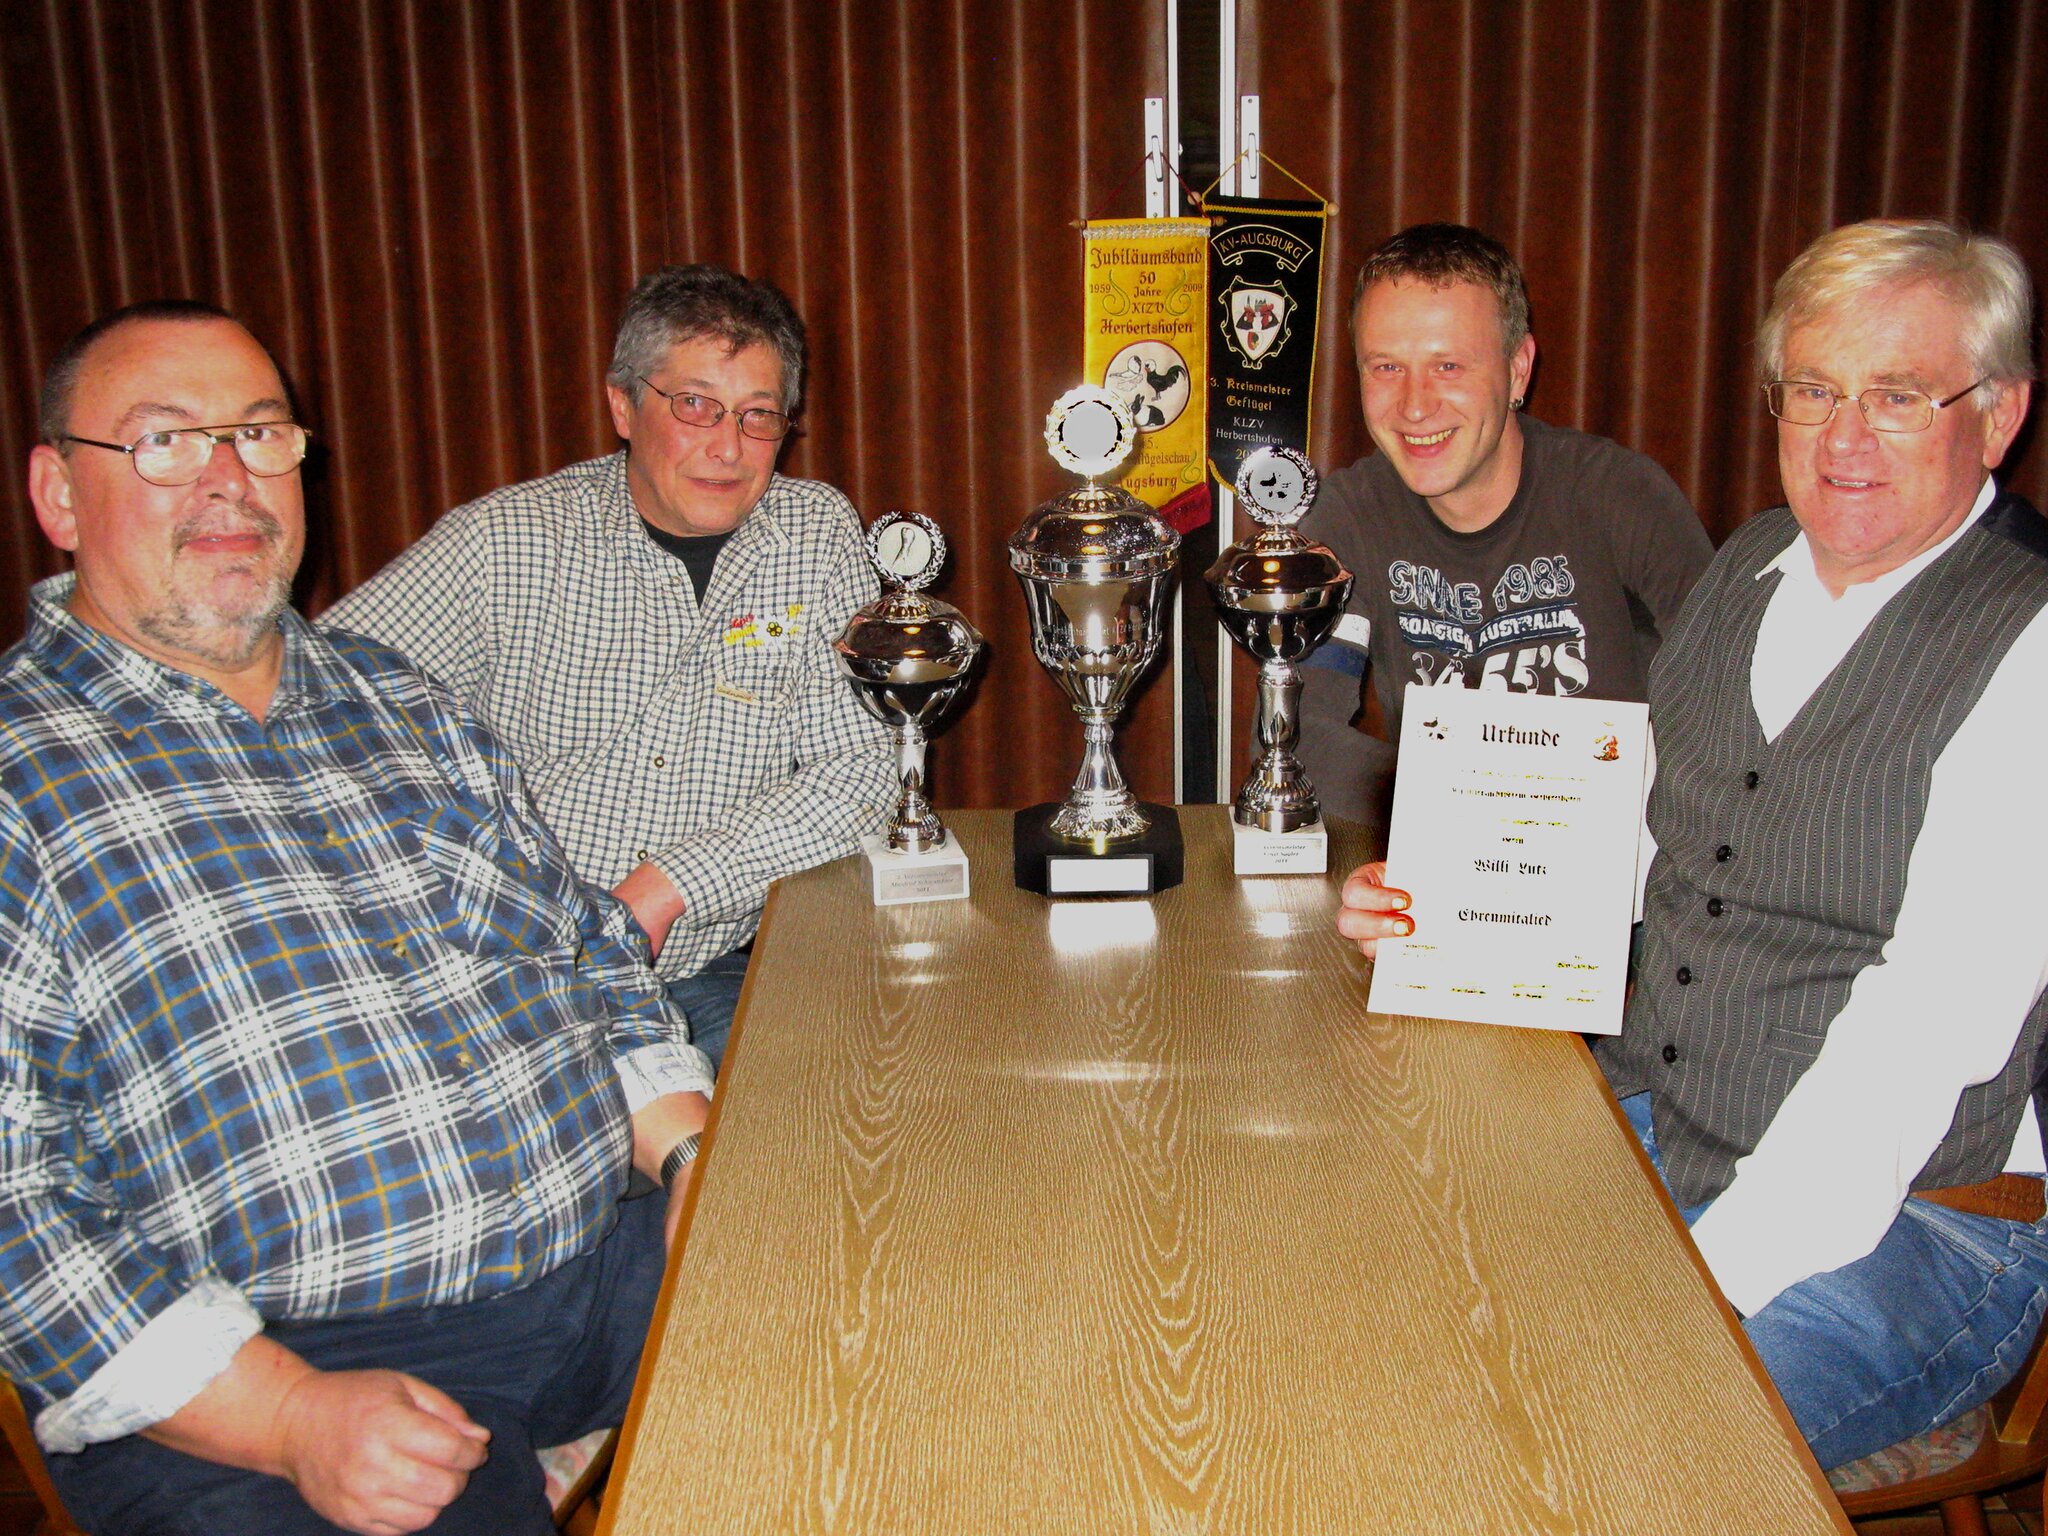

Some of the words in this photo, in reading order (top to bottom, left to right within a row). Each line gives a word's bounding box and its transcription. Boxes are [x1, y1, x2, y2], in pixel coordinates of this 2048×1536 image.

[1219, 232, 1303, 260] KV-AUGSBURG
[1090, 246, 1202, 269] Jubiläumsband
[1139, 271, 1156, 285] 50
[1090, 283, 1111, 294] 1959
[1133, 286, 1162, 298] Jahre
[1183, 283, 1203, 293] 2009
[1100, 317, 1193, 340] Herbertshofen
[1226, 377, 1292, 396] Kreismeister
[1226, 394, 1272, 411] Geflügel
[1233, 416, 1264, 429] KLZV
[1216, 428, 1284, 445] Herbertshofen
[1122, 473, 1177, 495] ugsburg
[1482, 723, 1560, 747] Urkunde
